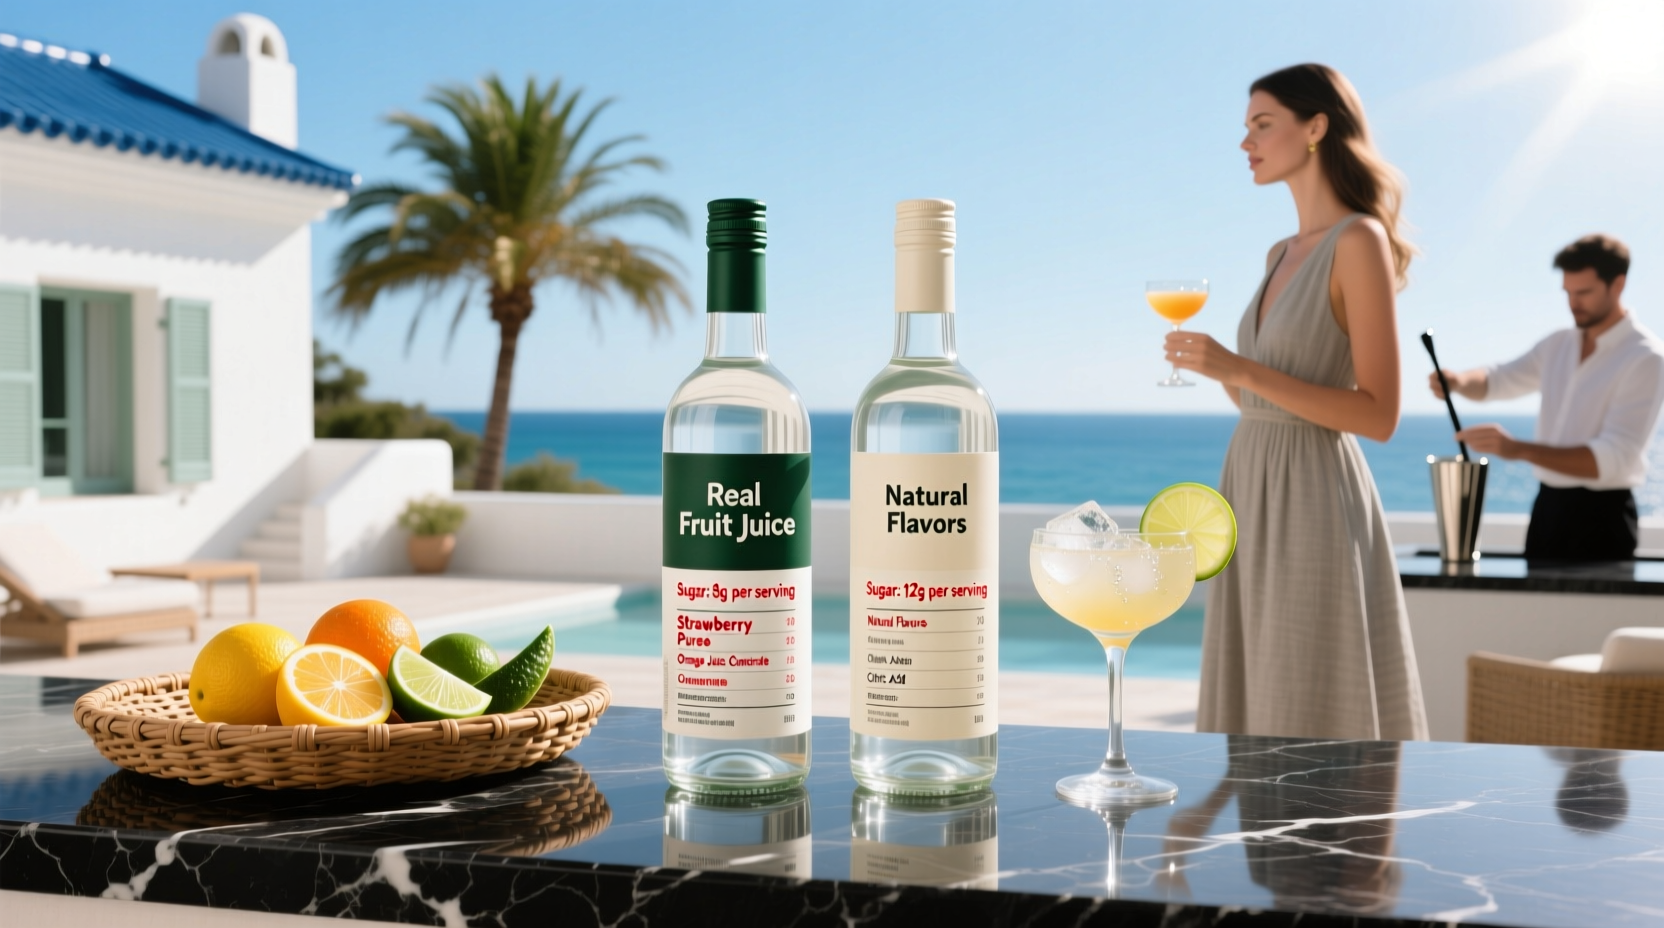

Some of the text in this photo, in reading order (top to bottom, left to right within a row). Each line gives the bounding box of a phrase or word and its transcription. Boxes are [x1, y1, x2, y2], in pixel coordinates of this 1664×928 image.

[707, 481, 761, 507] Real
[886, 482, 968, 506] Natural
[679, 511, 796, 543] Fruit Juice
[887, 511, 967, 534] Flavors
[732, 587, 752, 603] per
[754, 583, 796, 601] serving
[866, 580, 988, 602] Sugar: 12g per serving
[677, 615, 753, 635] Strawberry
